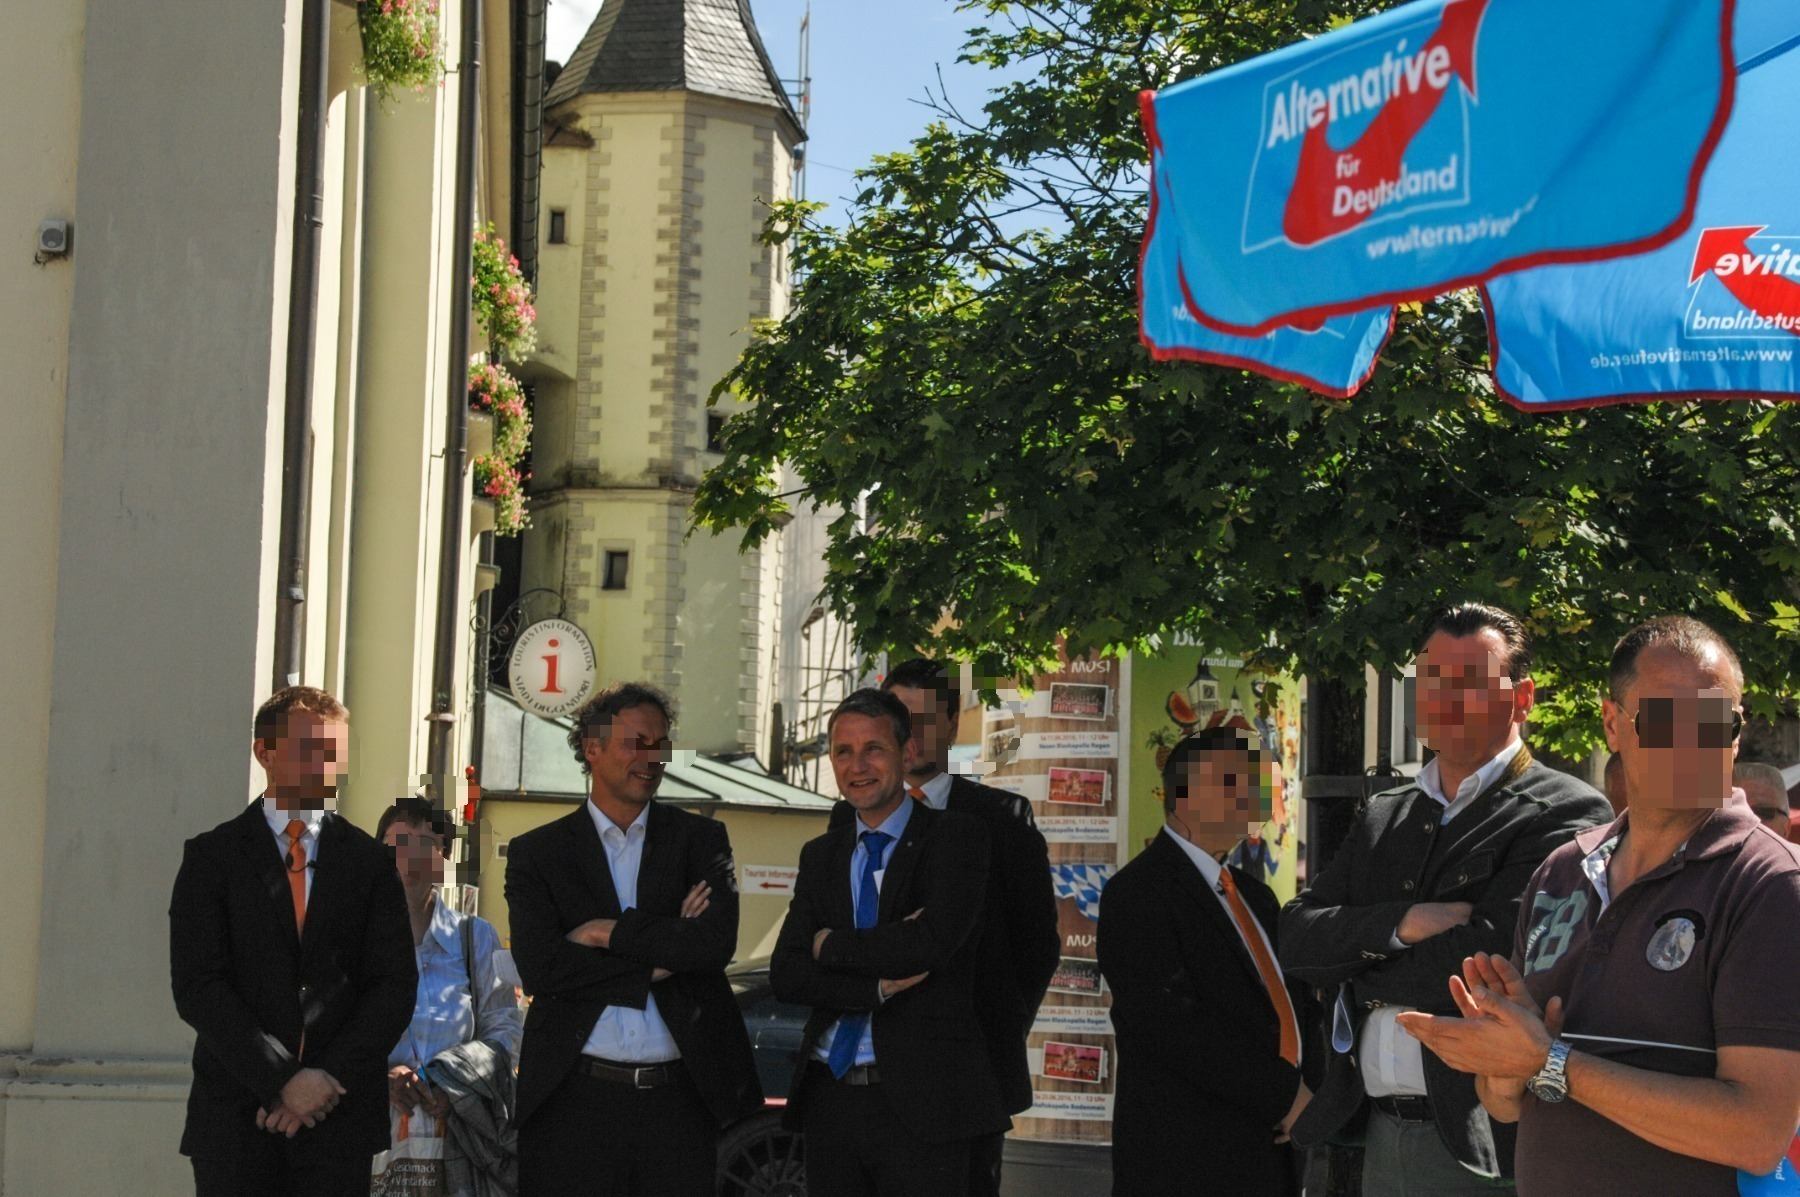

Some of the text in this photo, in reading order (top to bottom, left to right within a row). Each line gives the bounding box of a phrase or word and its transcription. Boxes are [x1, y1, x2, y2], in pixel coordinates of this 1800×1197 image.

[1267, 38, 1450, 149] Alternative
[1336, 153, 1361, 179] für
[513, 621, 593, 672] TOURISTINFORMATION
[1071, 660, 1111, 674] MUSI
[1201, 656, 1227, 668] rund
